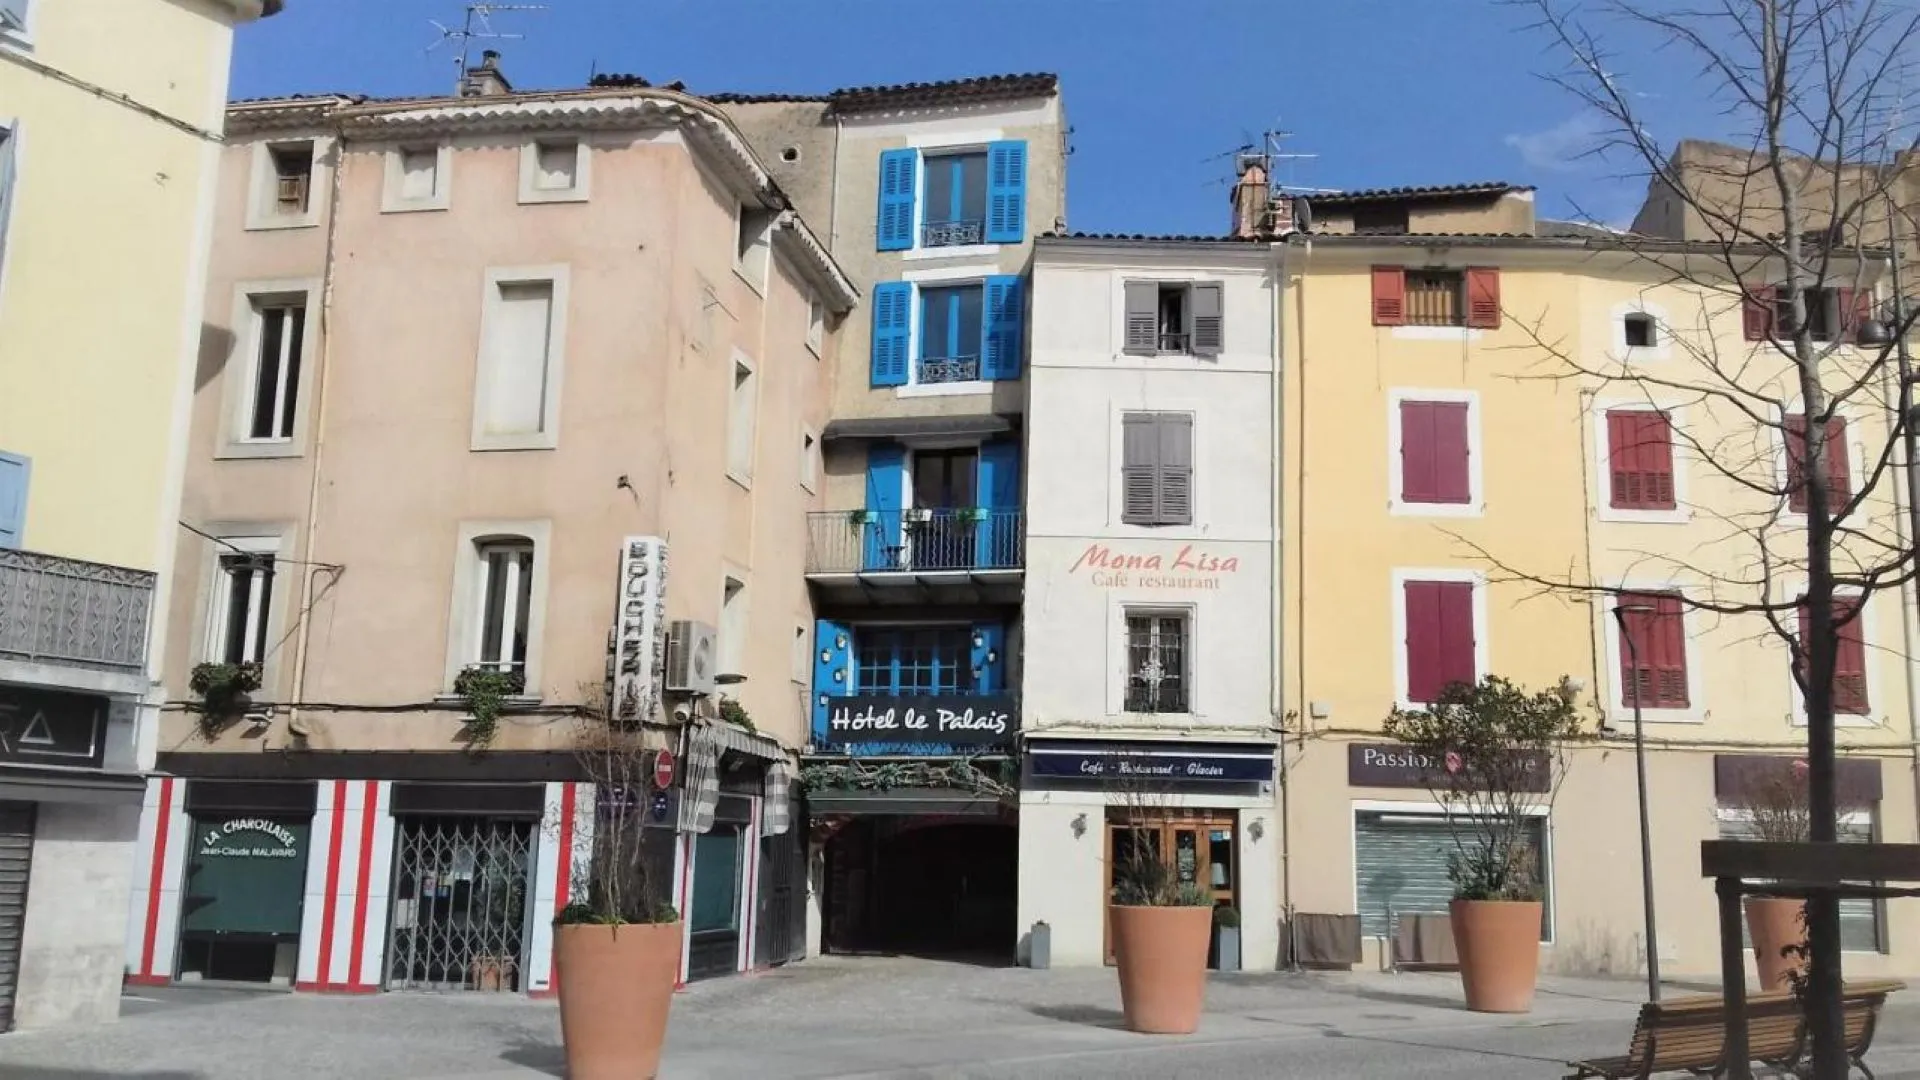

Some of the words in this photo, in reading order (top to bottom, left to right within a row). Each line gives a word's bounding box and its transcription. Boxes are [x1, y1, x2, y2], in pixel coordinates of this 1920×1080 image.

[1069, 544, 1163, 573] Mona
[1171, 544, 1239, 573] Lisa
[1139, 576, 1221, 589] restaurant
[831, 704, 899, 731] Hôtel
[904, 707, 929, 730] le
[935, 707, 1008, 735] Palais
[203, 830, 221, 846] LA
